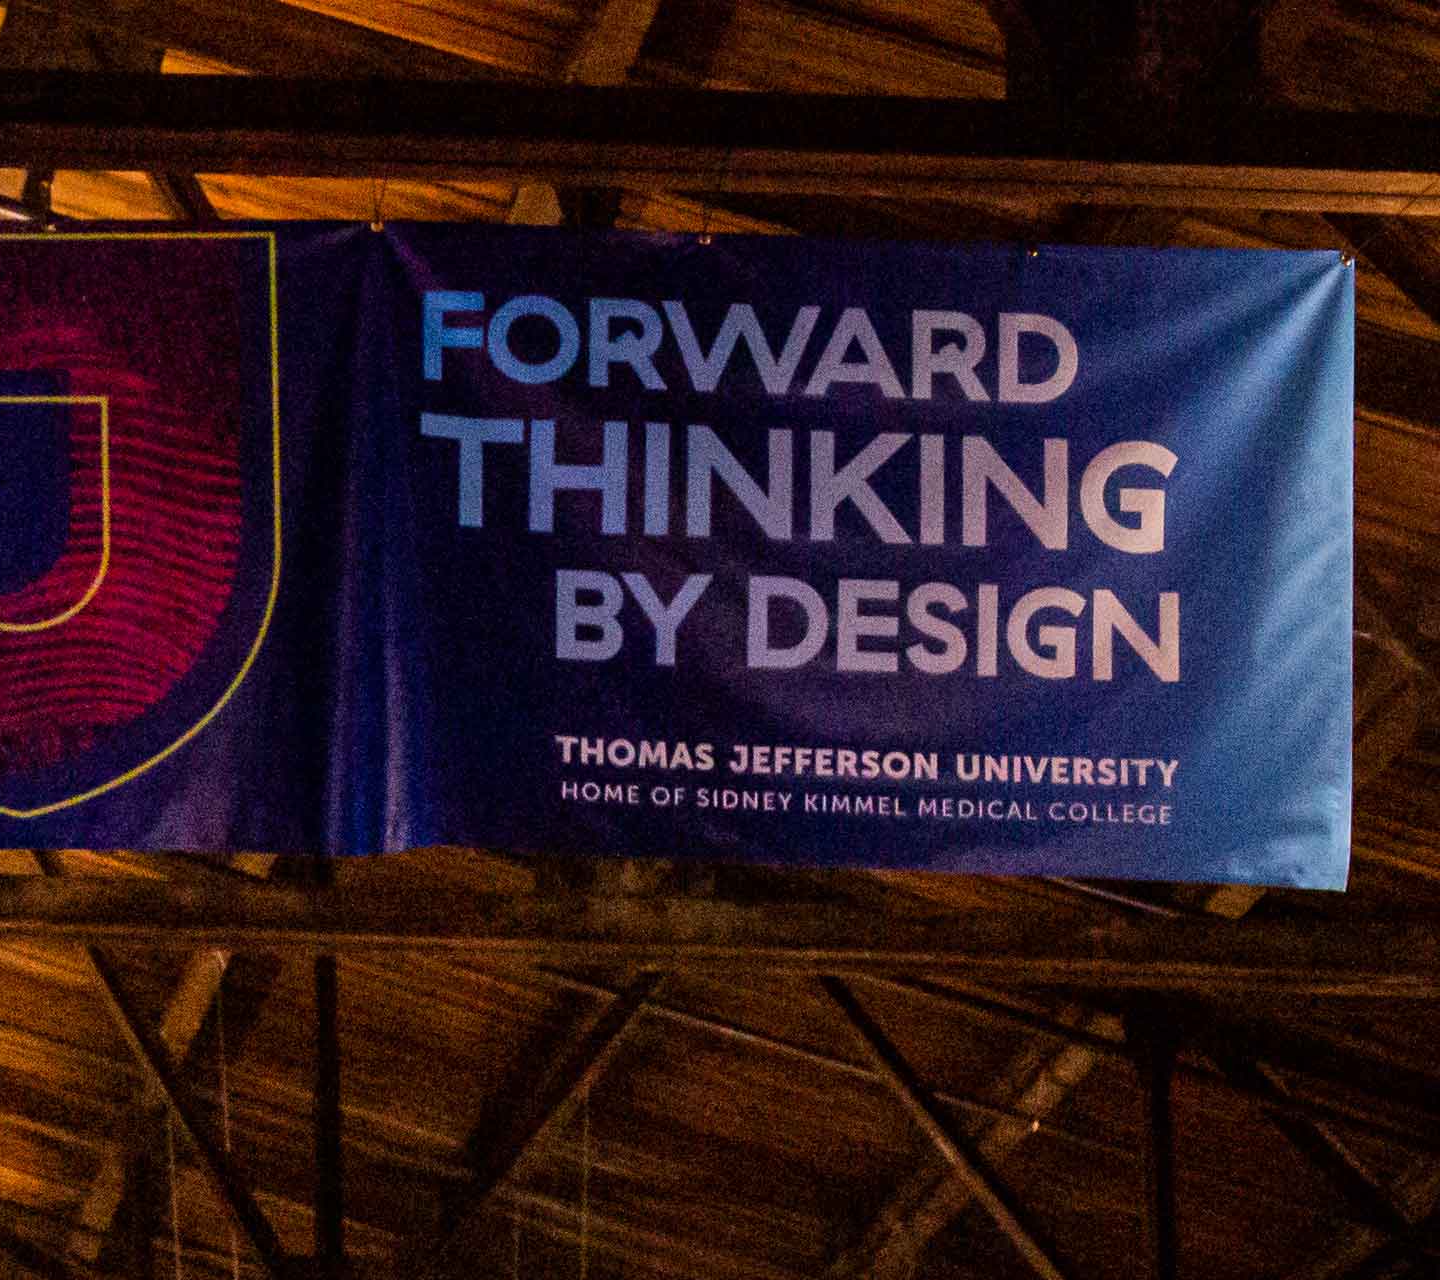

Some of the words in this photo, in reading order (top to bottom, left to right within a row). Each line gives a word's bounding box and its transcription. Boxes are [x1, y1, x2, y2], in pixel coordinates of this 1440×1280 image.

[421, 290, 1079, 402] FORWARD
[419, 412, 1179, 553] THINKING
[555, 570, 711, 667] BY
[746, 575, 1180, 682] DESIGN
[555, 735, 714, 771] THOMAS
[730, 745, 939, 780] JEFFERSON
[957, 755, 1179, 787] UNIVERSITY
[562, 782, 639, 804] HOME
[651, 786, 685, 807] OF
[696, 789, 792, 812] SIDNEY
[804, 793, 906, 817] KIMMEL
[918, 798, 1037, 821] MEDICAL
[1049, 802, 1173, 826] COLLEGE
